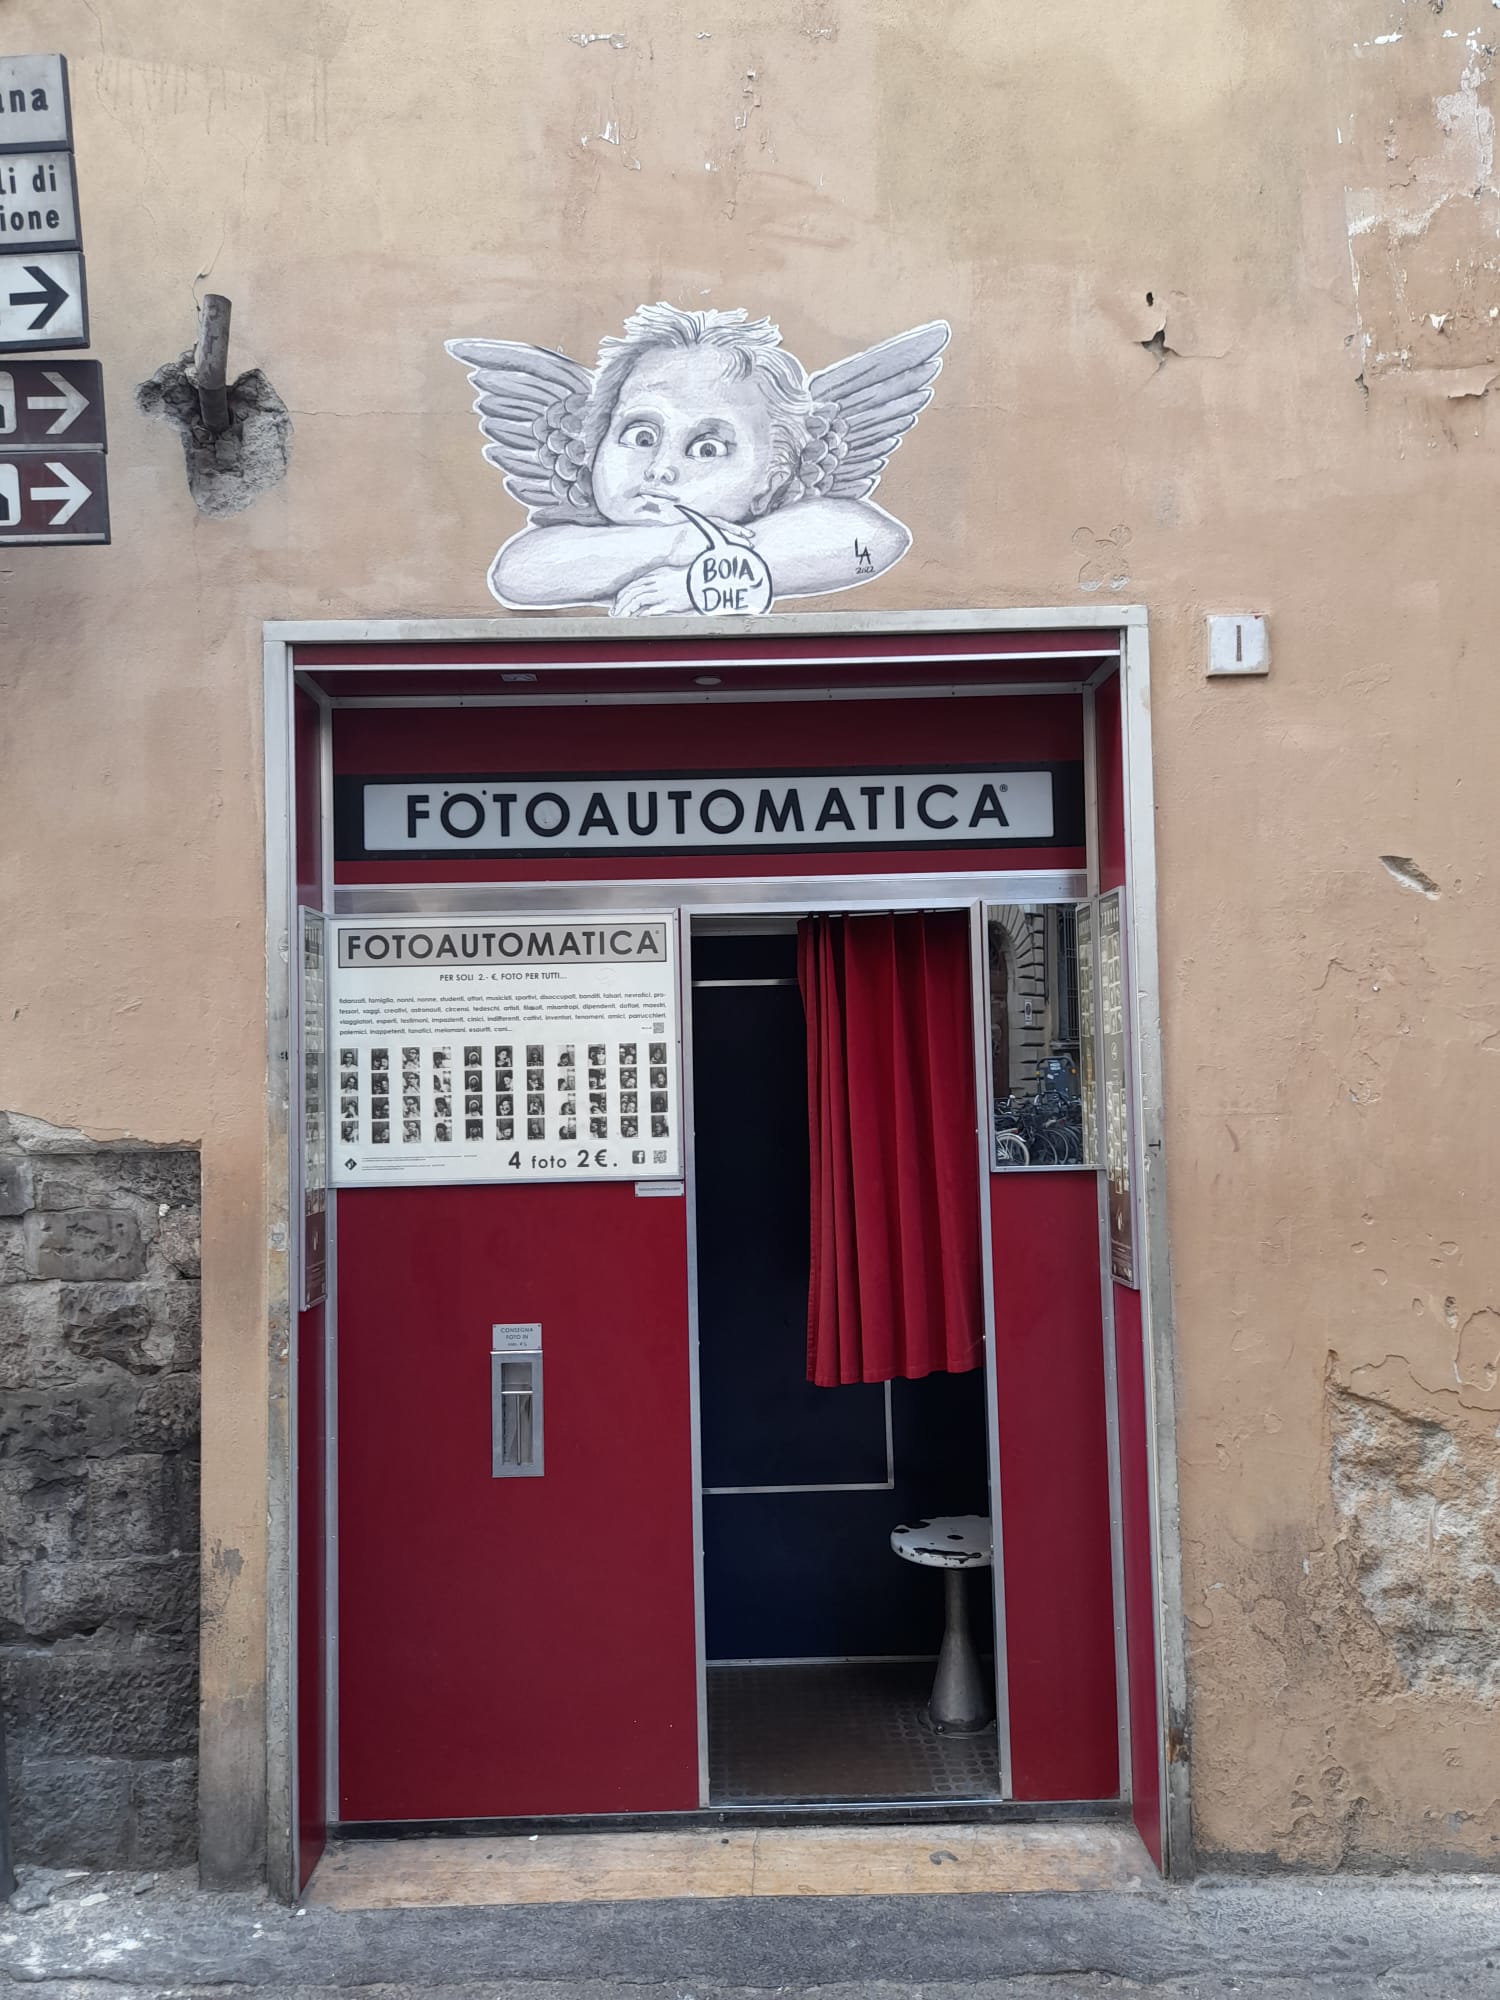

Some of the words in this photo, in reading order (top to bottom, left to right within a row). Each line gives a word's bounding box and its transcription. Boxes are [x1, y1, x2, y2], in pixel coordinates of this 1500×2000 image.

[32, 164, 57, 192] di
[439, 974, 454, 982] PER
[500, 972, 523, 980] FOTO
[525, 972, 539, 980] PER
[508, 1151, 521, 1169] 4
[531, 1155, 567, 1168] foto
